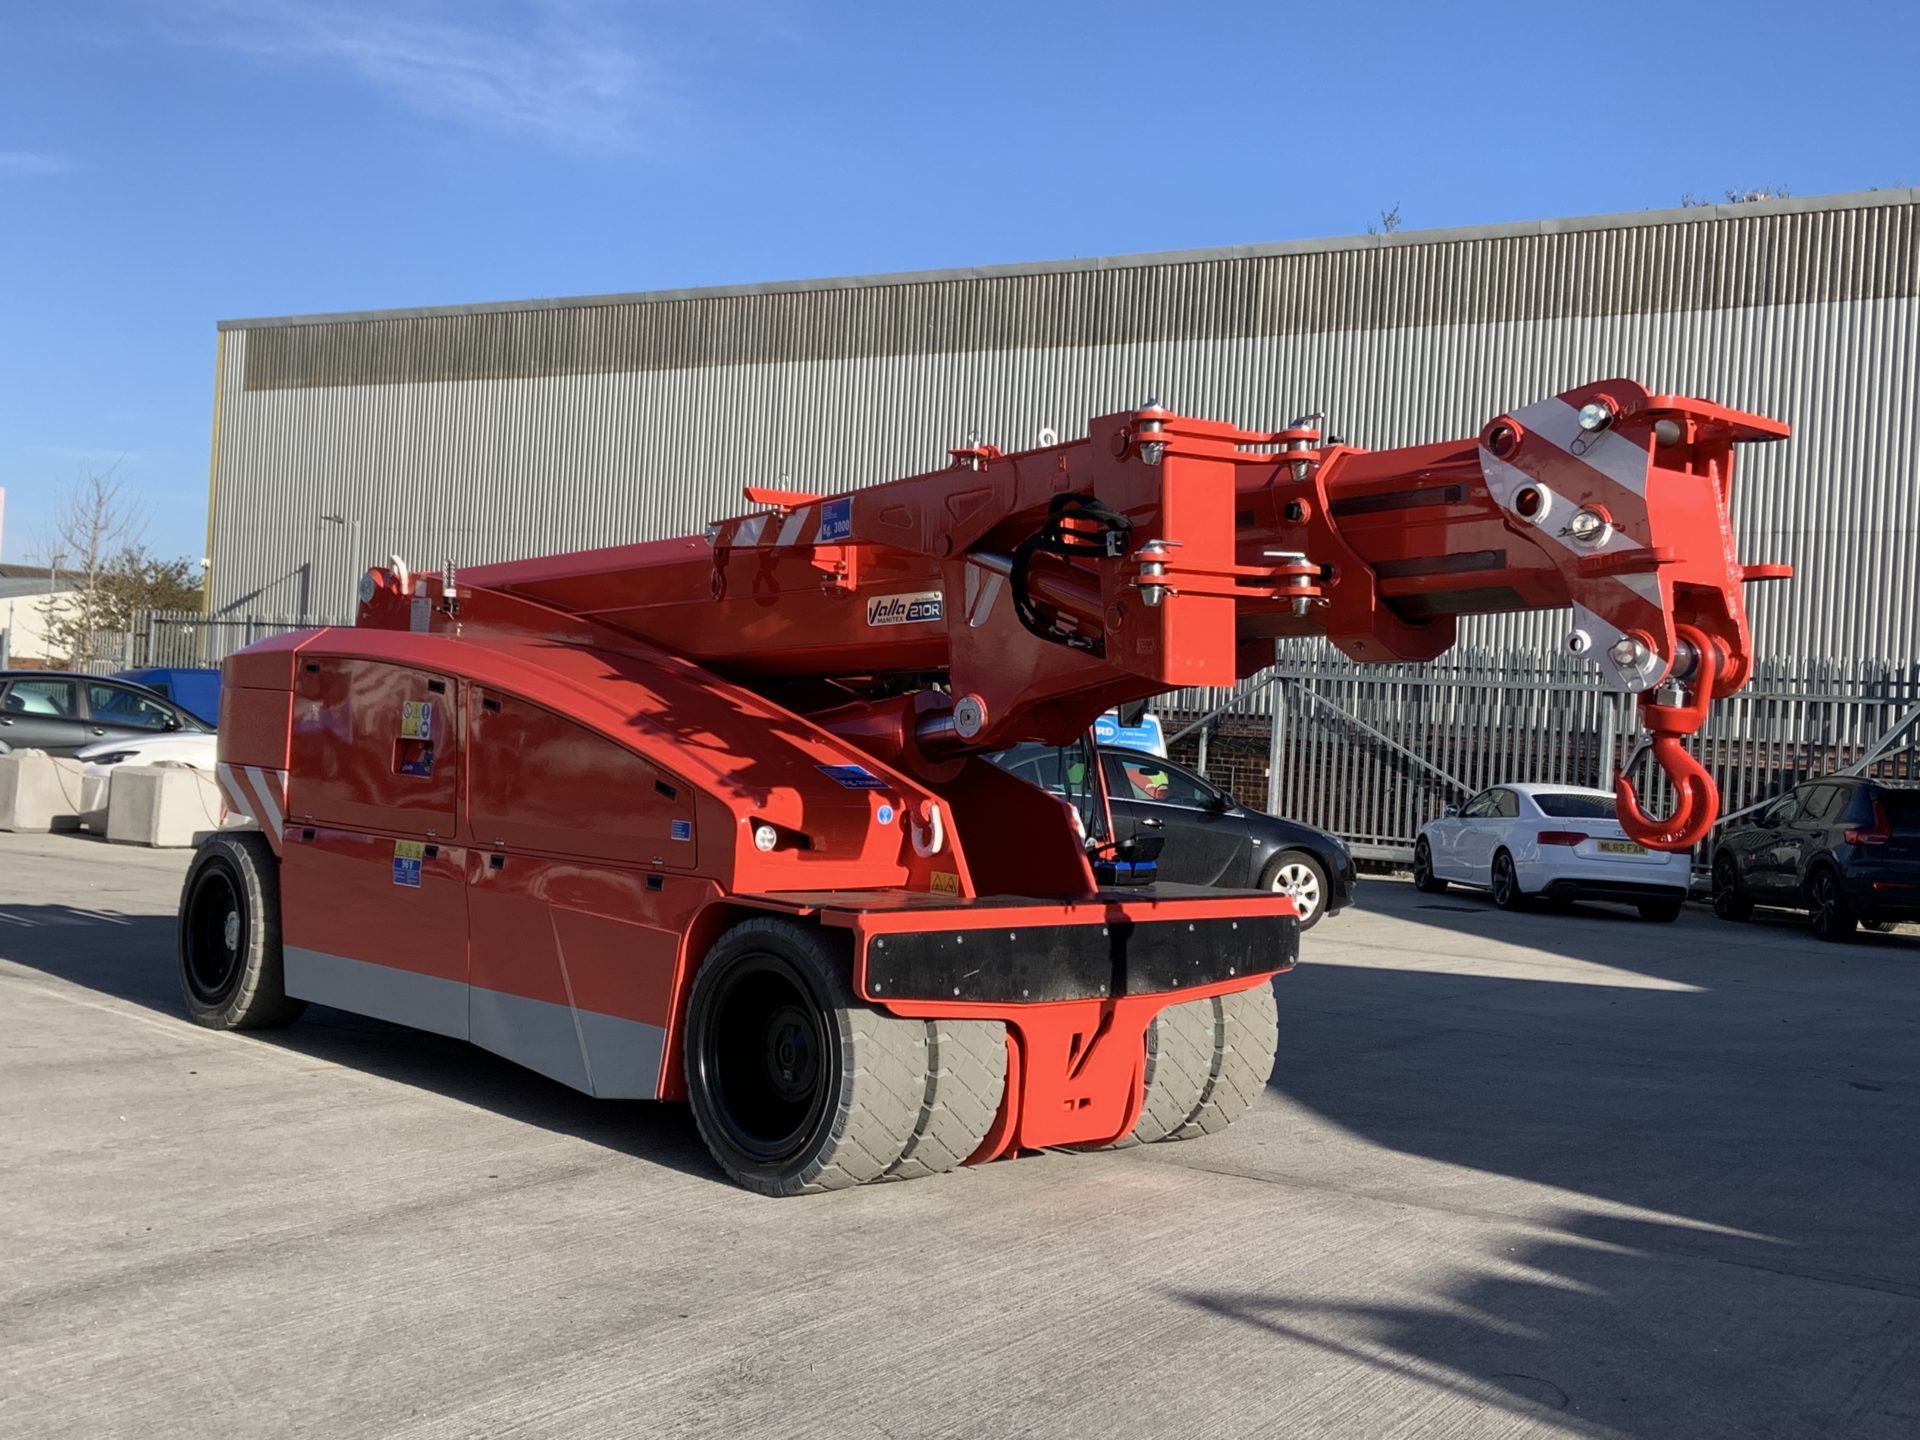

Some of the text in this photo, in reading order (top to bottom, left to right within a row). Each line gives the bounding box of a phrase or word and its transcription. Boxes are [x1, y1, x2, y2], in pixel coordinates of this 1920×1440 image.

[834, 520, 850, 533] 3000
[869, 599, 940, 624] Valla 210R
[877, 616, 904, 624] MANITEX
[1096, 727, 1114, 736] RD
